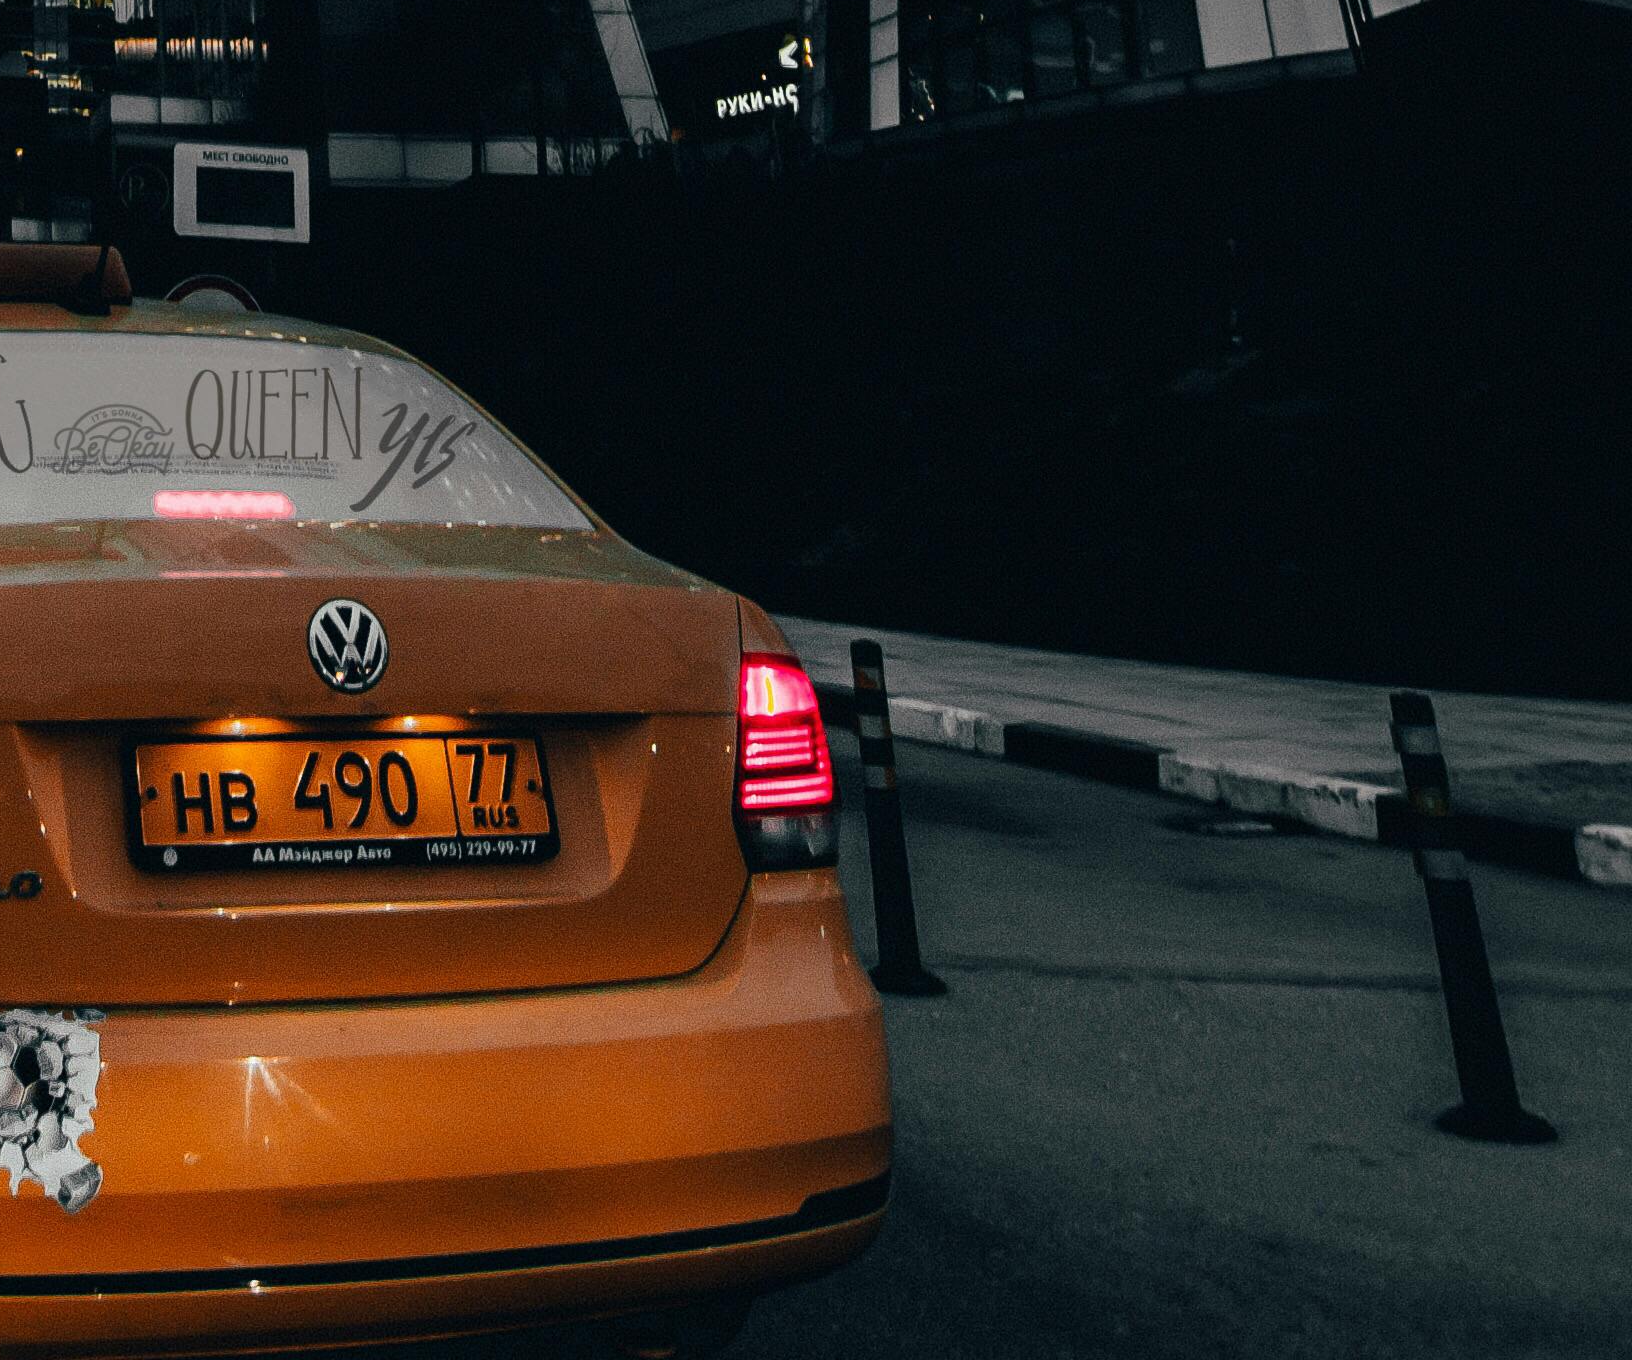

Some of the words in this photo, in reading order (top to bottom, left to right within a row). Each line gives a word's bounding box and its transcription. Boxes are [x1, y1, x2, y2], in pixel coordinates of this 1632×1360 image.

[232, 152, 289, 165] СВОБОДНО
[185, 367, 363, 460] QUEEN
[293, 749, 419, 830] 490
[454, 743, 517, 804] 77
[472, 806, 521, 829] RUS
